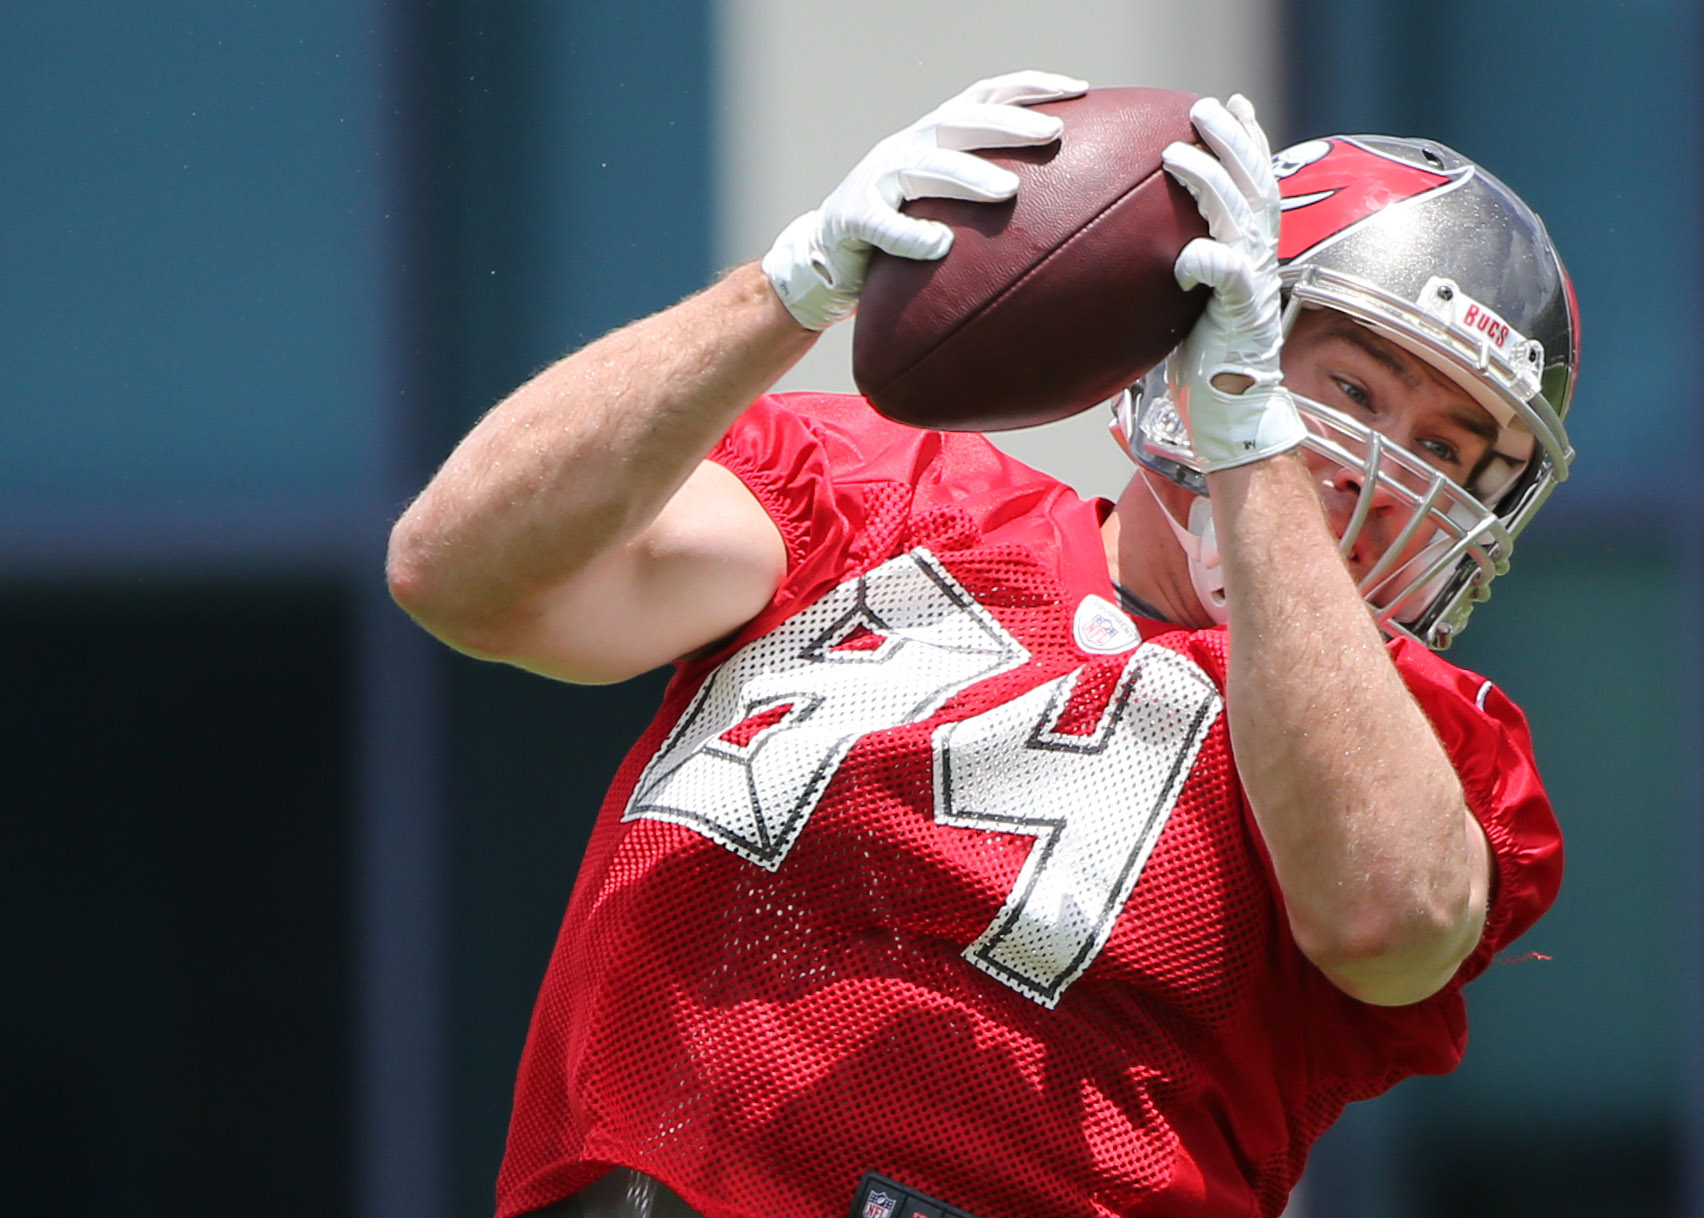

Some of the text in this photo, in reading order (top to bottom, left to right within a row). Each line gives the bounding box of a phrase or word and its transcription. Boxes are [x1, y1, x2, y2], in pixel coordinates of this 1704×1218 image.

[1463, 303, 1510, 348] BUCS
[1085, 619, 1109, 645] NFL
[620, 546, 1224, 1011] 84
